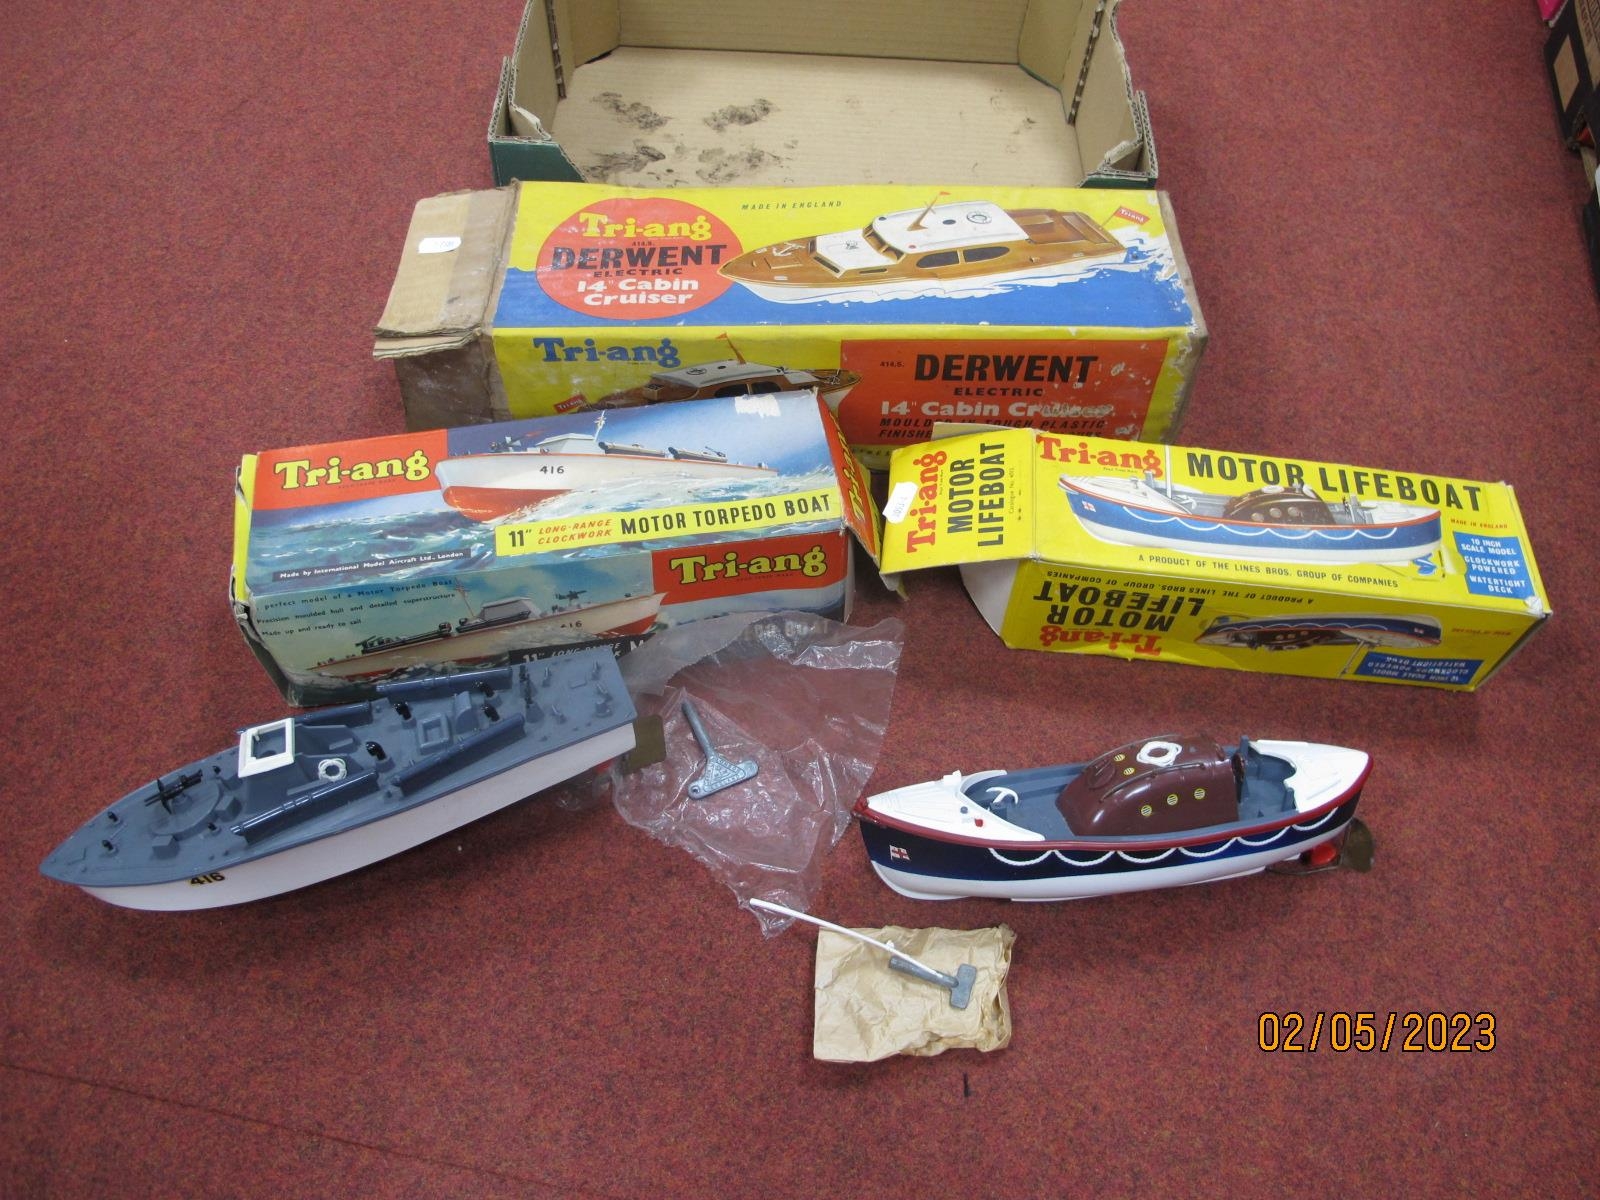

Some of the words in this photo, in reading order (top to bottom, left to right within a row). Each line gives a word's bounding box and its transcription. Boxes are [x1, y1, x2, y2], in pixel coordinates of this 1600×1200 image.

[792, 200, 842, 208] ENGLAND
[578, 211, 712, 241] Tri-ang
[551, 244, 728, 271] DERWENT
[593, 267, 683, 278] ELECTRIC
[618, 278, 699, 291] Cabin
[583, 291, 694, 306] Cruiser
[532, 337, 681, 369] Tri-ang
[914, 353, 1099, 383] DERWENT
[953, 387, 1044, 397] ELECTRIC
[921, 401, 1000, 416] Cabin
[1041, 420, 1106, 429] PLASTIC
[879, 429, 933, 438] FINISHE
[1035, 435, 1163, 479] Tri-ang
[274, 449, 431, 490] Tri-ang
[540, 464, 565, 474] 416
[1186, 452, 1304, 487] MOTOR
[1318, 467, 1481, 512] LIFEBOAT
[906, 450, 948, 554] Tri-ang
[948, 458, 974, 533] MOTOR
[977, 442, 1005, 547] LIFEBOAT
[621, 512, 687, 535] MOTOR
[693, 502, 776, 528] TORPEDO
[785, 494, 830, 516] BOAT
[538, 518, 612, 535] LONG-RANGE
[538, 528, 612, 545] CLOCKWORK
[314, 564, 359, 574] International
[363, 560, 385, 568] Model
[389, 556, 417, 565] Aircraft
[670, 545, 828, 585] Tri-ang
[1464, 556, 1520, 567] CLOCKWORK
[1472, 564, 1516, 574] POWERED
[1047, 570, 1102, 584] COMPANIES
[1149, 555, 1190, 566] PRODUCT
[1213, 561, 1230, 570] THE
[1234, 563, 1261, 574] LINES
[1297, 569, 1327, 580] GROUP
[1332, 573, 1343, 581] OF
[1347, 575, 1399, 588] COMPANIES
[1124, 581, 1155, 590] GROUP
[1469, 575, 1526, 587] WATERTIGHT
[1487, 585, 1513, 594] DECK
[1033, 580, 1205, 617] LIFEBOAT
[1046, 604, 1175, 632] MOTOR
[1039, 625, 1162, 657] Tri-ang
[190, 872, 225, 885] 416
